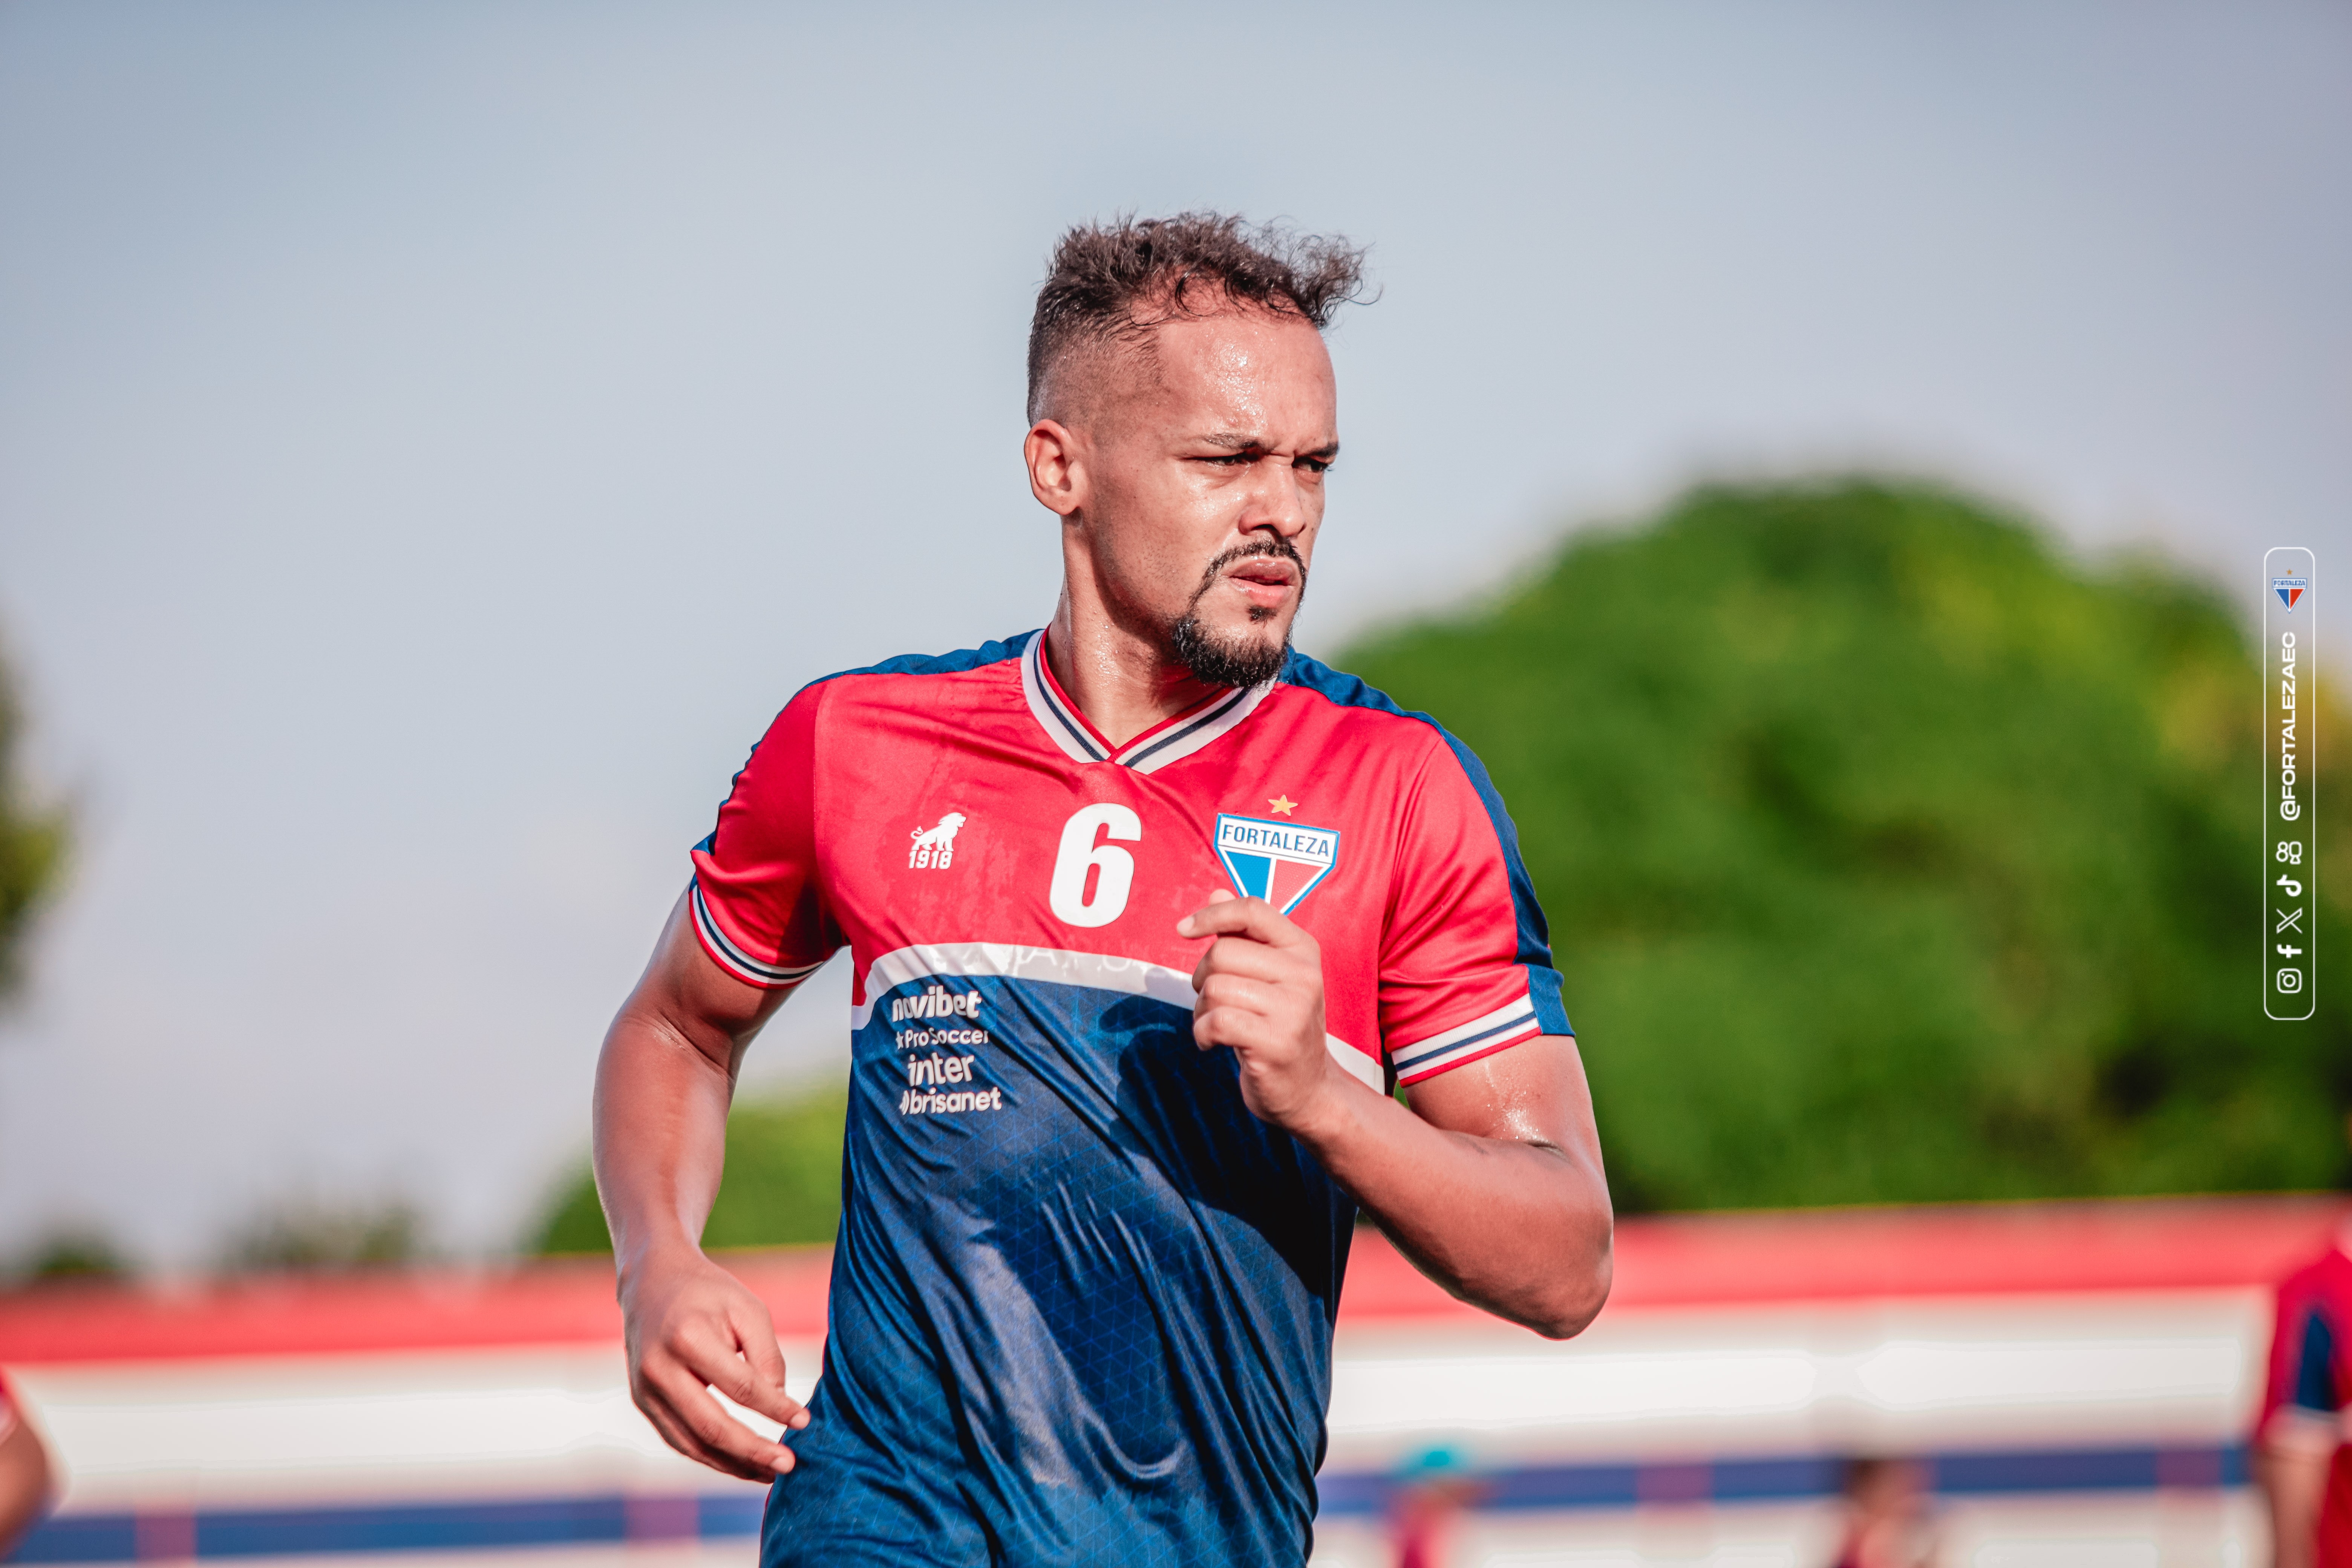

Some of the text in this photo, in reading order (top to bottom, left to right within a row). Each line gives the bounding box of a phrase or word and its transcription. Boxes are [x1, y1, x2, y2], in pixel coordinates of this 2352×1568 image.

[1222, 824, 1329, 857] FORTALEZA
[909, 850, 953, 870] 1918
[1049, 802, 1142, 928] 6
[892, 985, 982, 1023] novibet
[907, 1052, 974, 1087] inter
[910, 1087, 1002, 1115] brisanet
